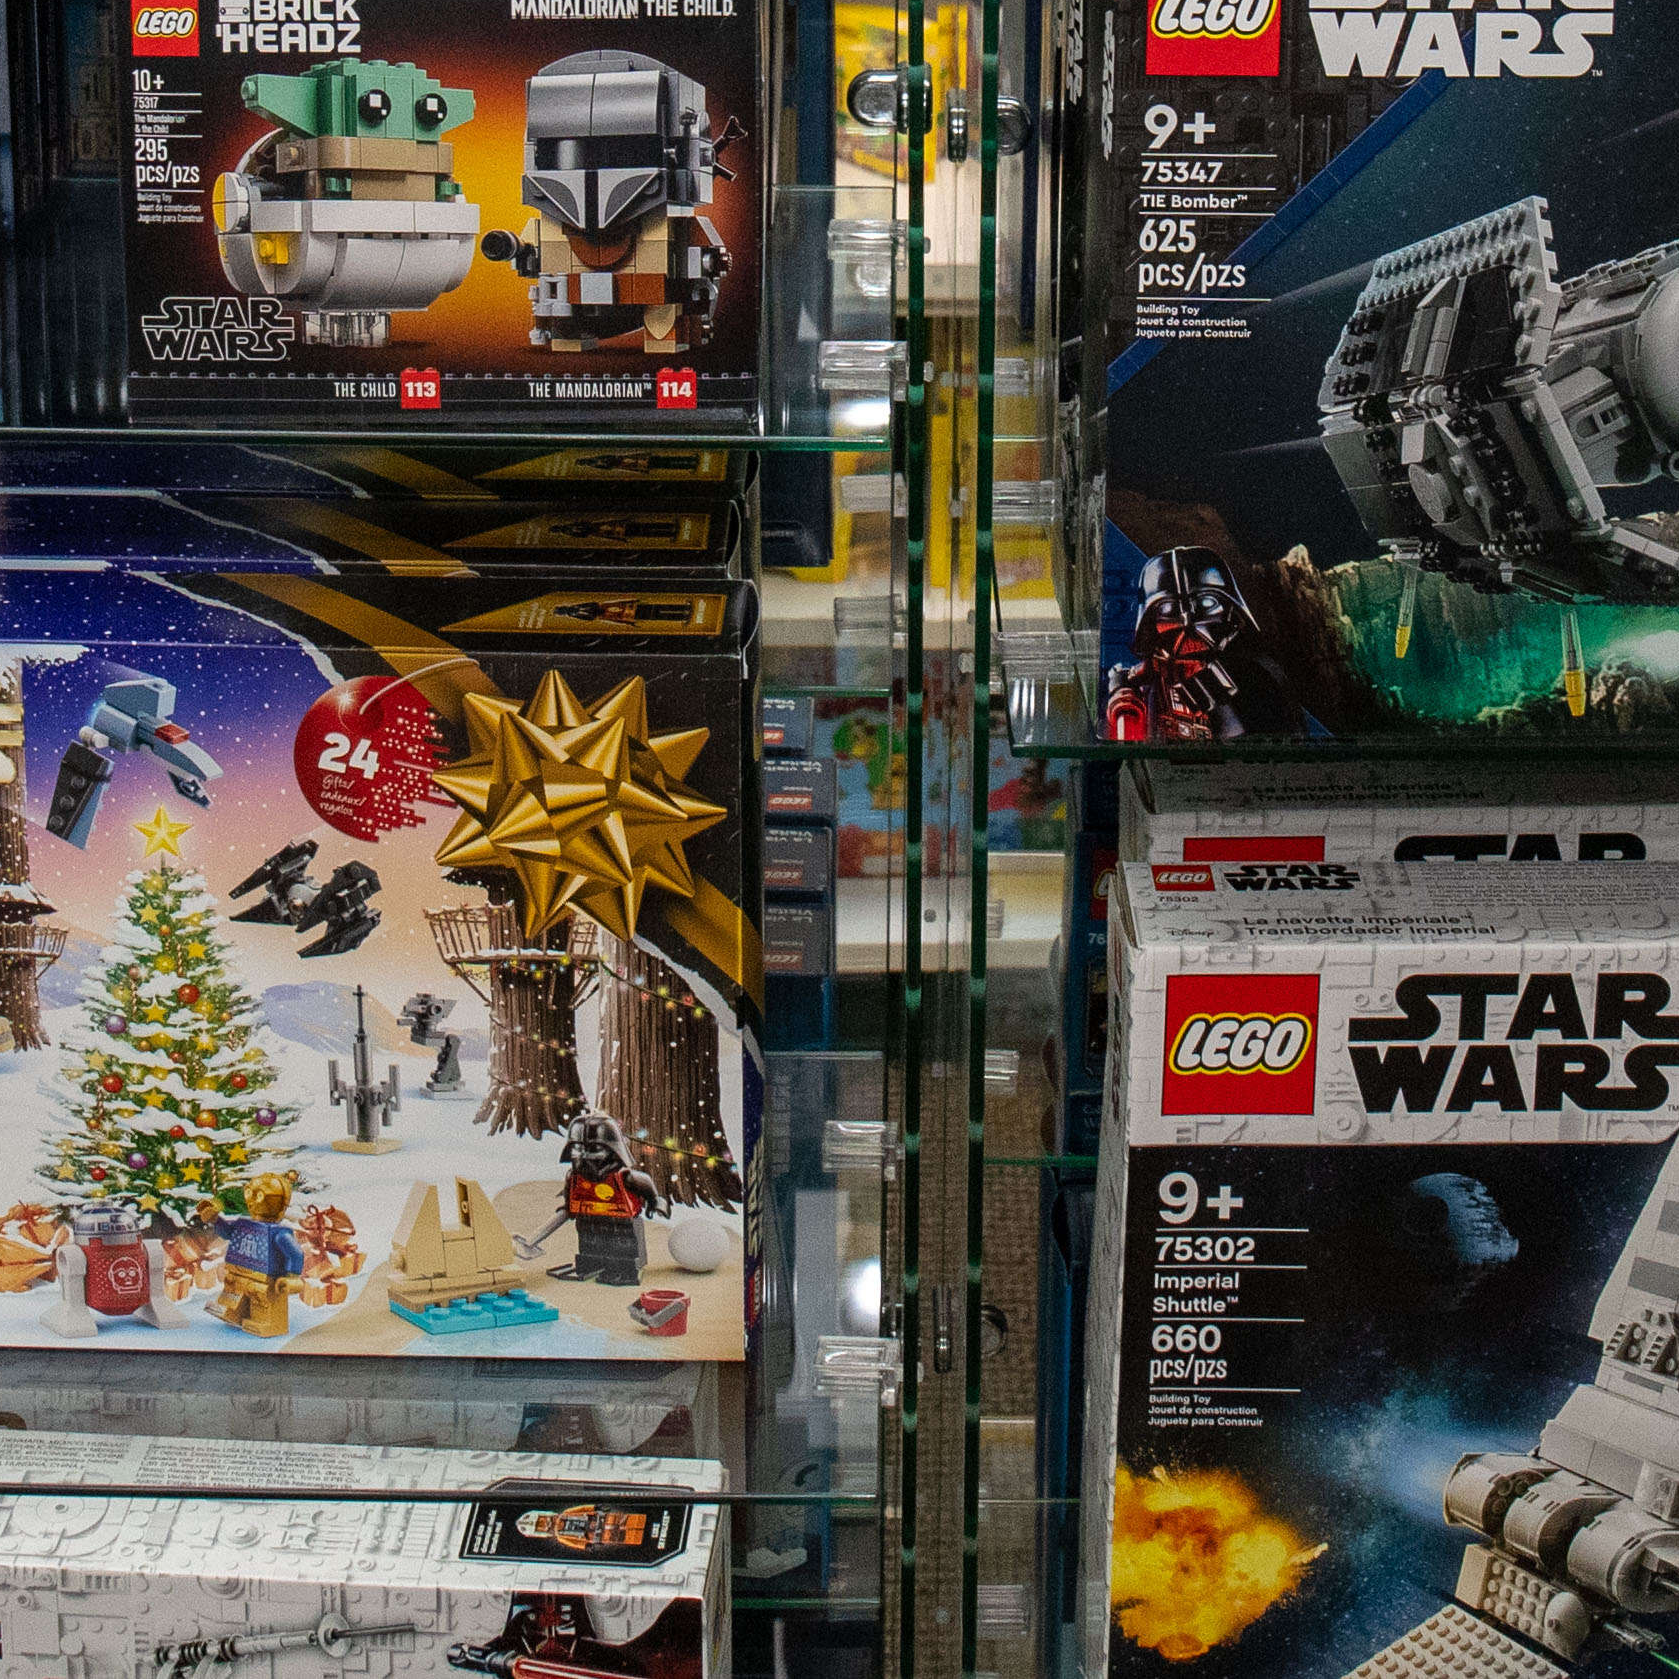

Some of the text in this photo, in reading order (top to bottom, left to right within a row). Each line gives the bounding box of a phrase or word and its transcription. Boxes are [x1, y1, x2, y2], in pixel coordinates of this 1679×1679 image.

[135, 7, 196, 37] LEGO
[1309, 13, 1615, 77] WARS
[132, 69, 164, 91] 10+
[133, 97, 159, 109] 75317
[1144, 104, 1216, 149] 9+
[135, 139, 168, 162] 295
[136, 161, 200, 188] pcs/pzs
[1141, 162, 1223, 183] 75347
[1140, 194, 1166, 207] TIE
[1139, 219, 1196, 252] 625
[1138, 252, 1246, 293] pcs/pzs
[142, 297, 295, 327] STAR
[1136, 305, 1200, 316] Building Toy
[1136, 317, 1247, 327] Jouet de construction
[142, 329, 295, 361] WARS
[1136, 328, 1252, 339] Juguete para Construir
[334, 382, 437, 399] THE CHILD 113
[529, 382, 554, 399] THE
[659, 382, 693, 399] 114
[318, 732, 380, 779] 24
[1225, 865, 1359, 878] STAR
[1226, 877, 1361, 891] WARS
[1172, 1019, 1305, 1070] LEGO
[1159, 1172, 1244, 1224] 9+
[1155, 1236, 1255, 1262] 75302
[1154, 1272, 1239, 1292] Imperial
[1151, 1324, 1221, 1353] 660
[1149, 1353, 1227, 1385] pcs/pzs
